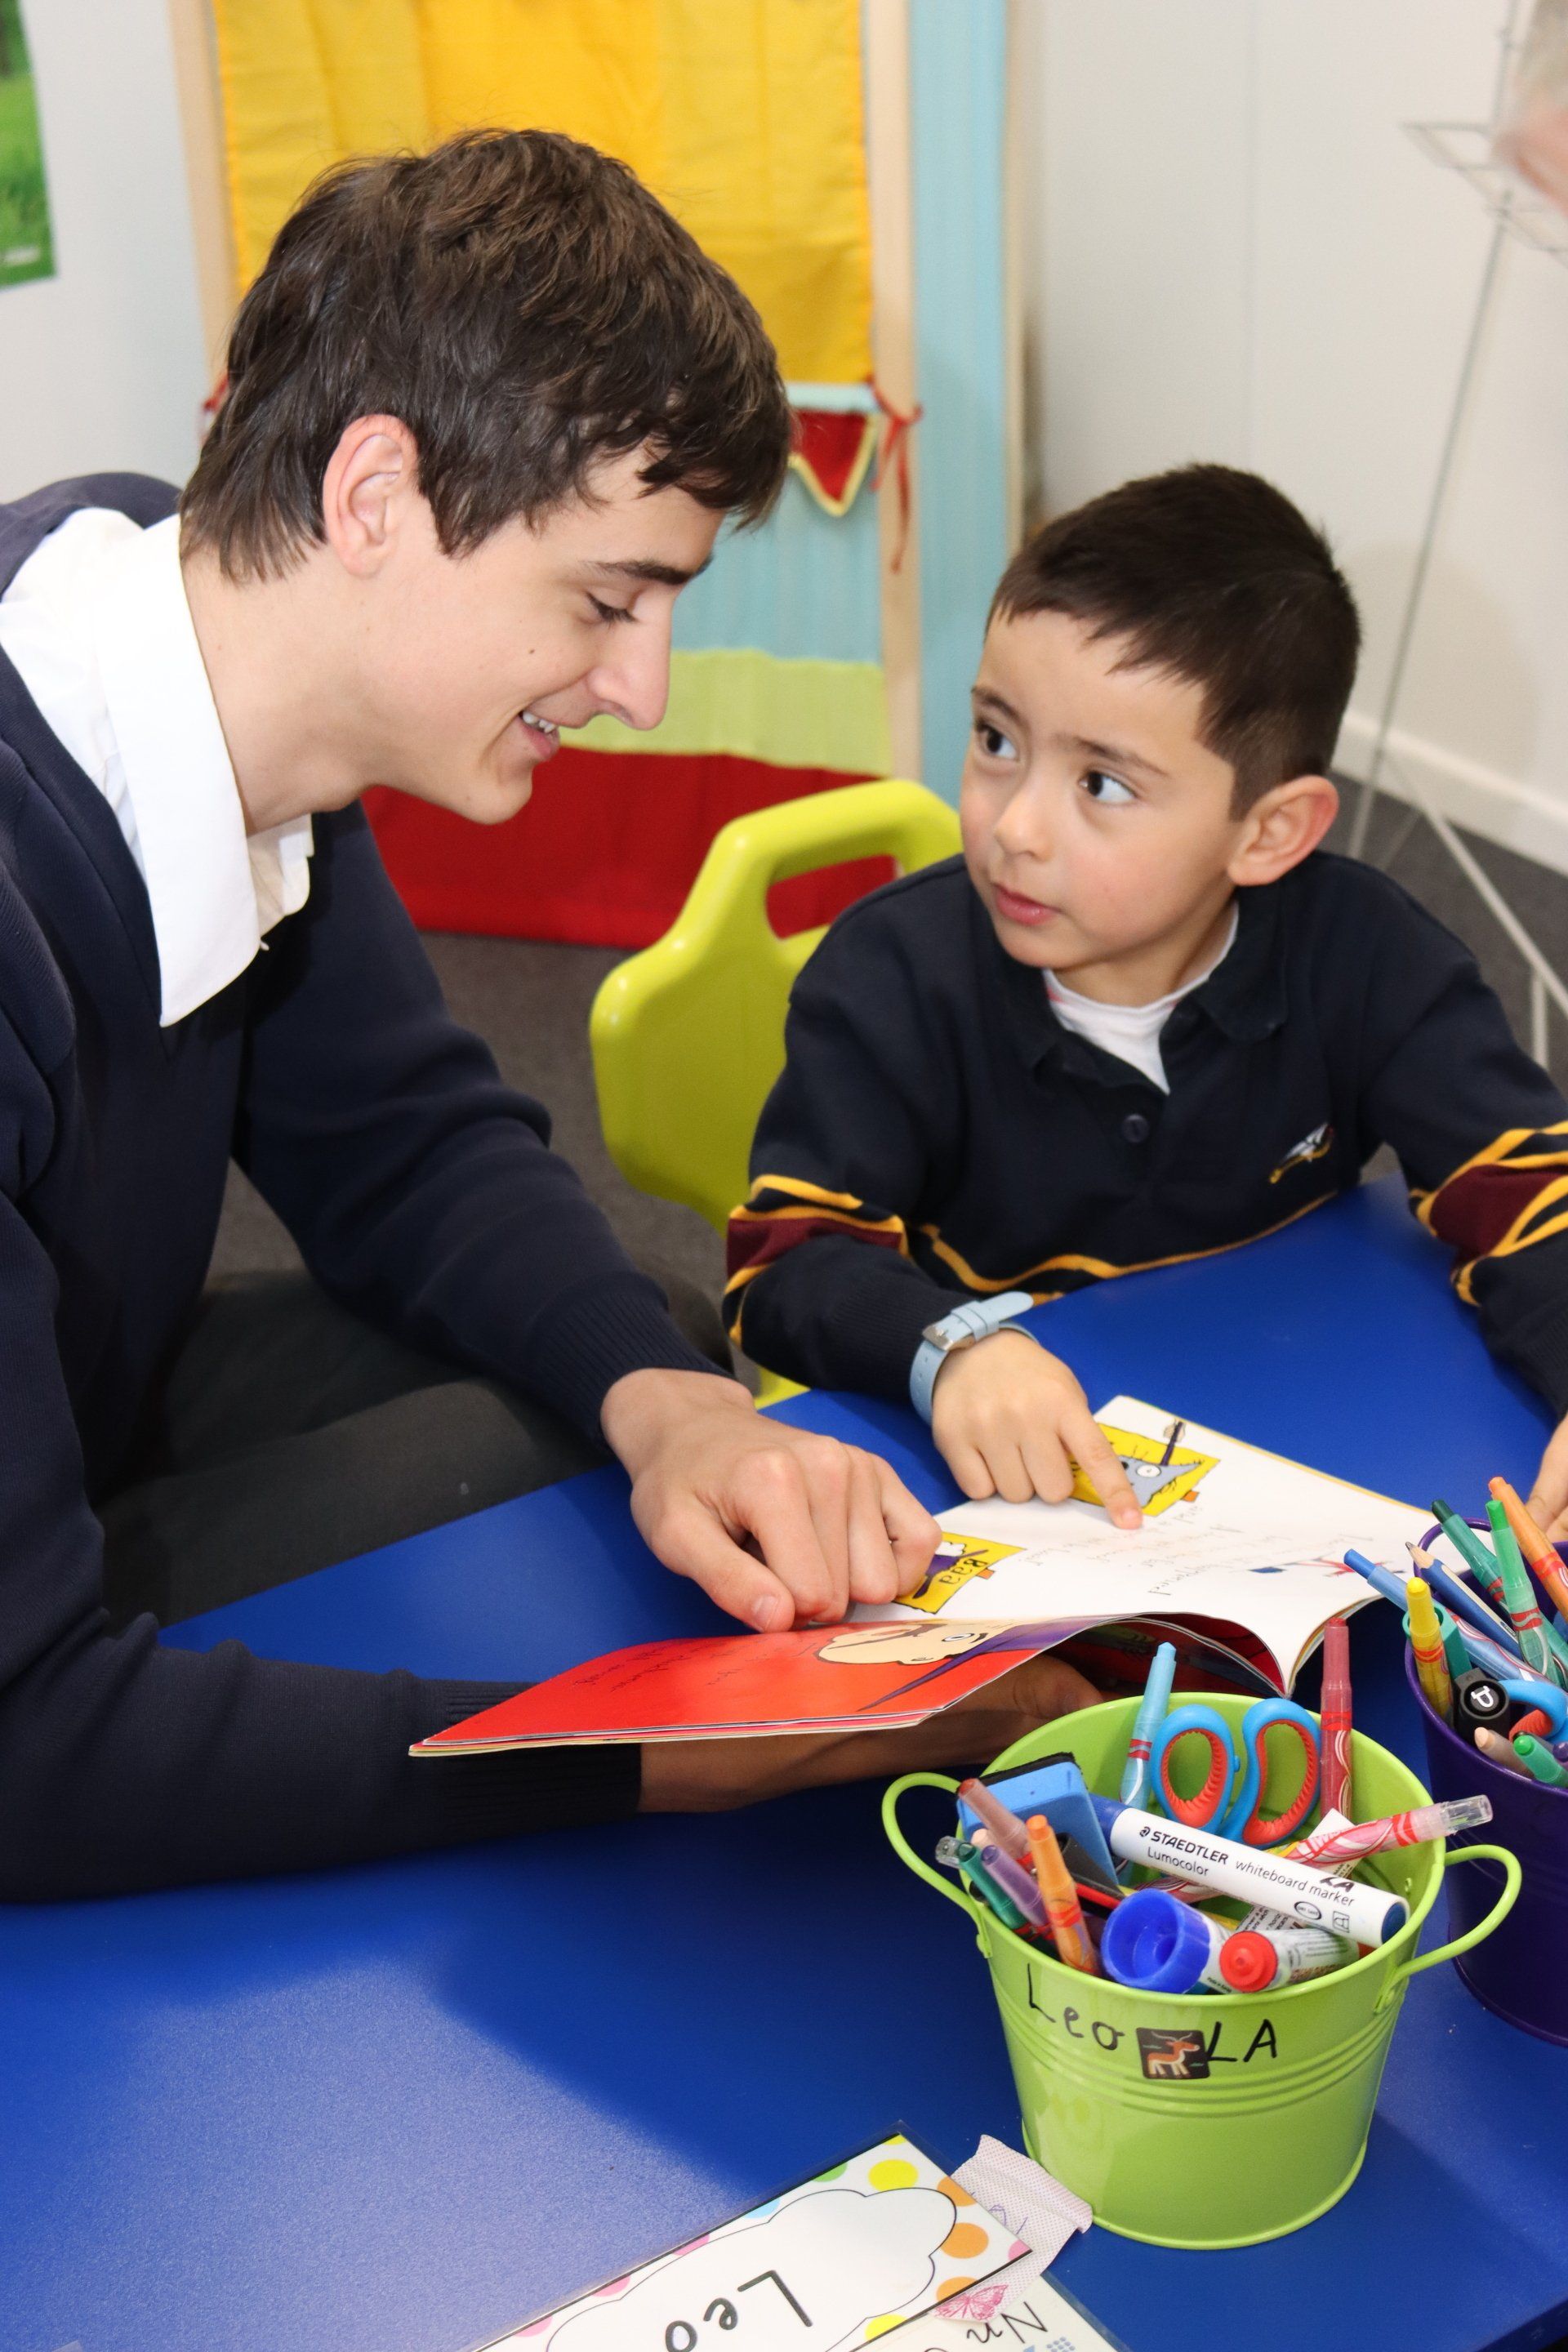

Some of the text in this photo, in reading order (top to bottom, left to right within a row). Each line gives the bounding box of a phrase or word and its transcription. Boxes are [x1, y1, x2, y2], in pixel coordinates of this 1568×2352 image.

[938, 1558, 988, 1584] Baa
[1147, 1847, 1209, 1877] Lumocolor
[1150, 1830, 1229, 1865] STAEDTLER
[1236, 1860, 1308, 1891] whiteboard
[1308, 1884, 1356, 1908] marker
[1027, 1962, 1277, 2063] Leo LA
[665, 2269, 813, 2352] Leo
